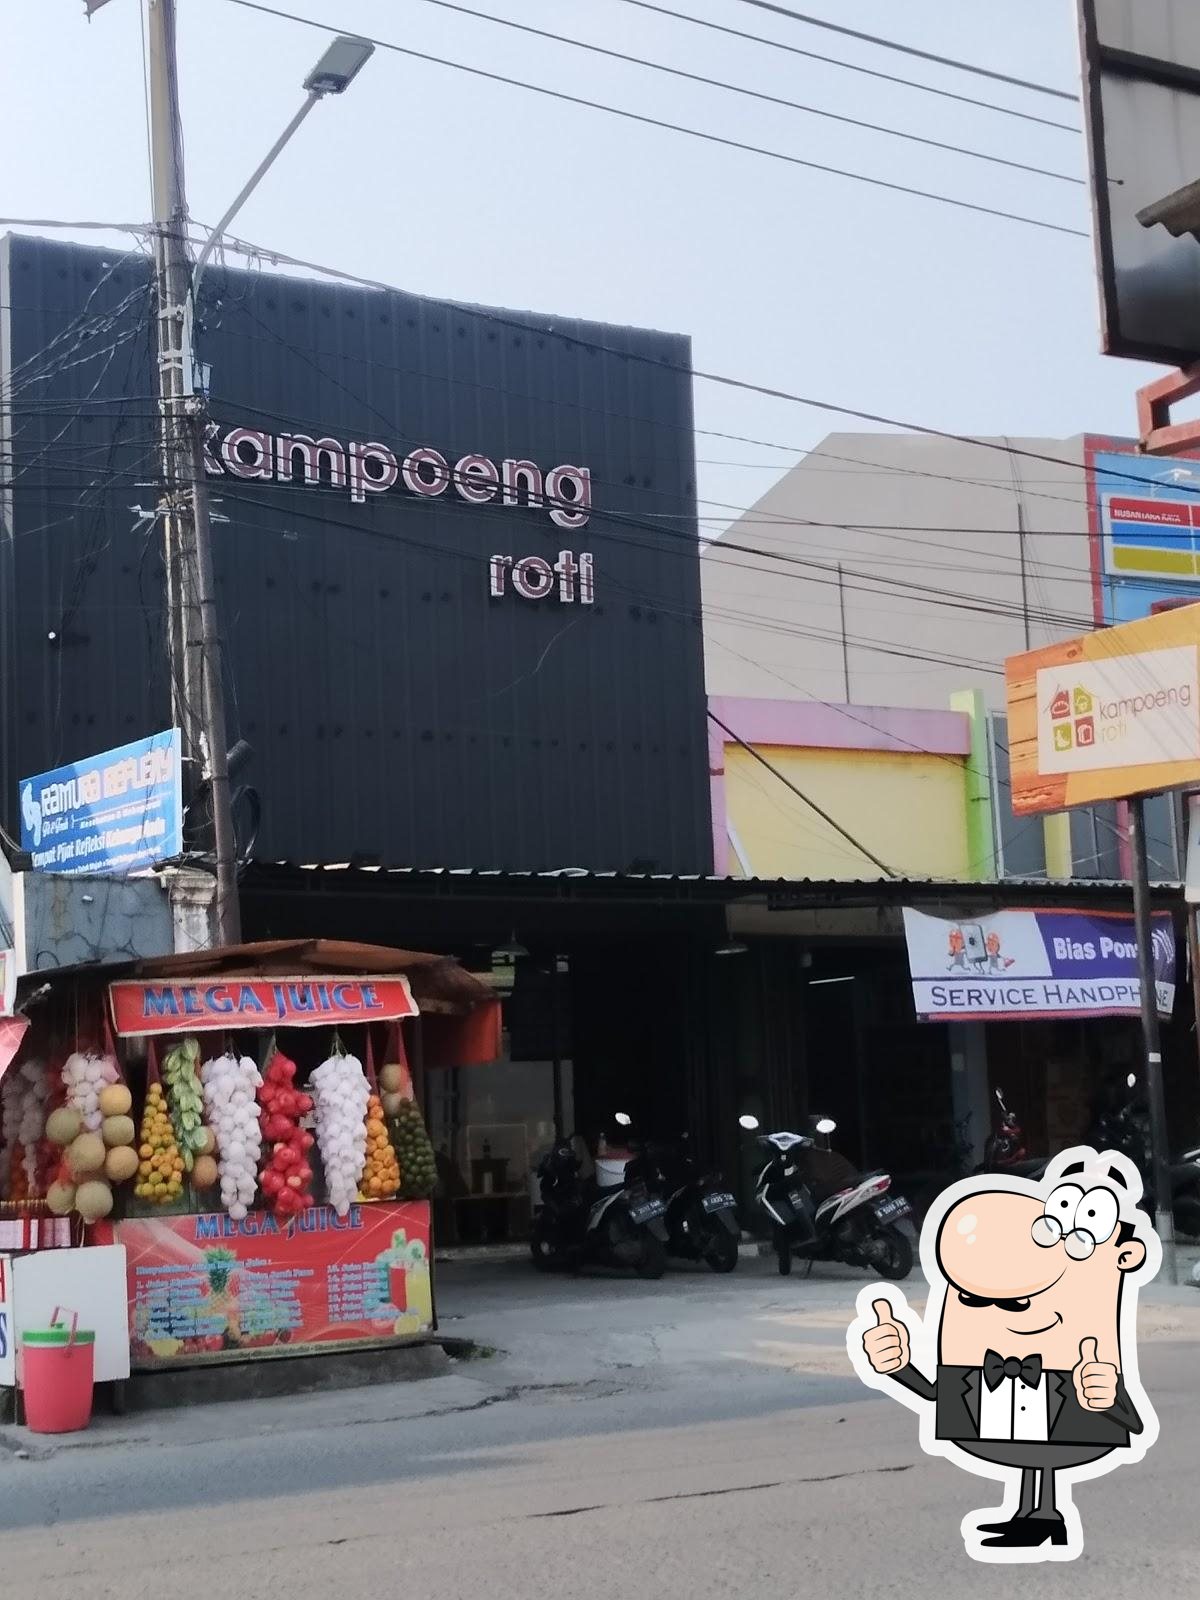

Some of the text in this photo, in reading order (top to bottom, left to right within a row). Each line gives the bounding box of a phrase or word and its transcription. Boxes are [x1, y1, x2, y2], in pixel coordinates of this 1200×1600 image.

[488, 550, 594, 604] roti
[1099, 684, 1190, 719] kampoeng
[1101, 721, 1127, 742] roti
[1054, 937, 1096, 960] Bias
[142, 983, 384, 1020] MEGA JUICE
[931, 984, 1169, 1007] SERVICE HANDPHNE
[195, 1210, 281, 1241] MEGA
